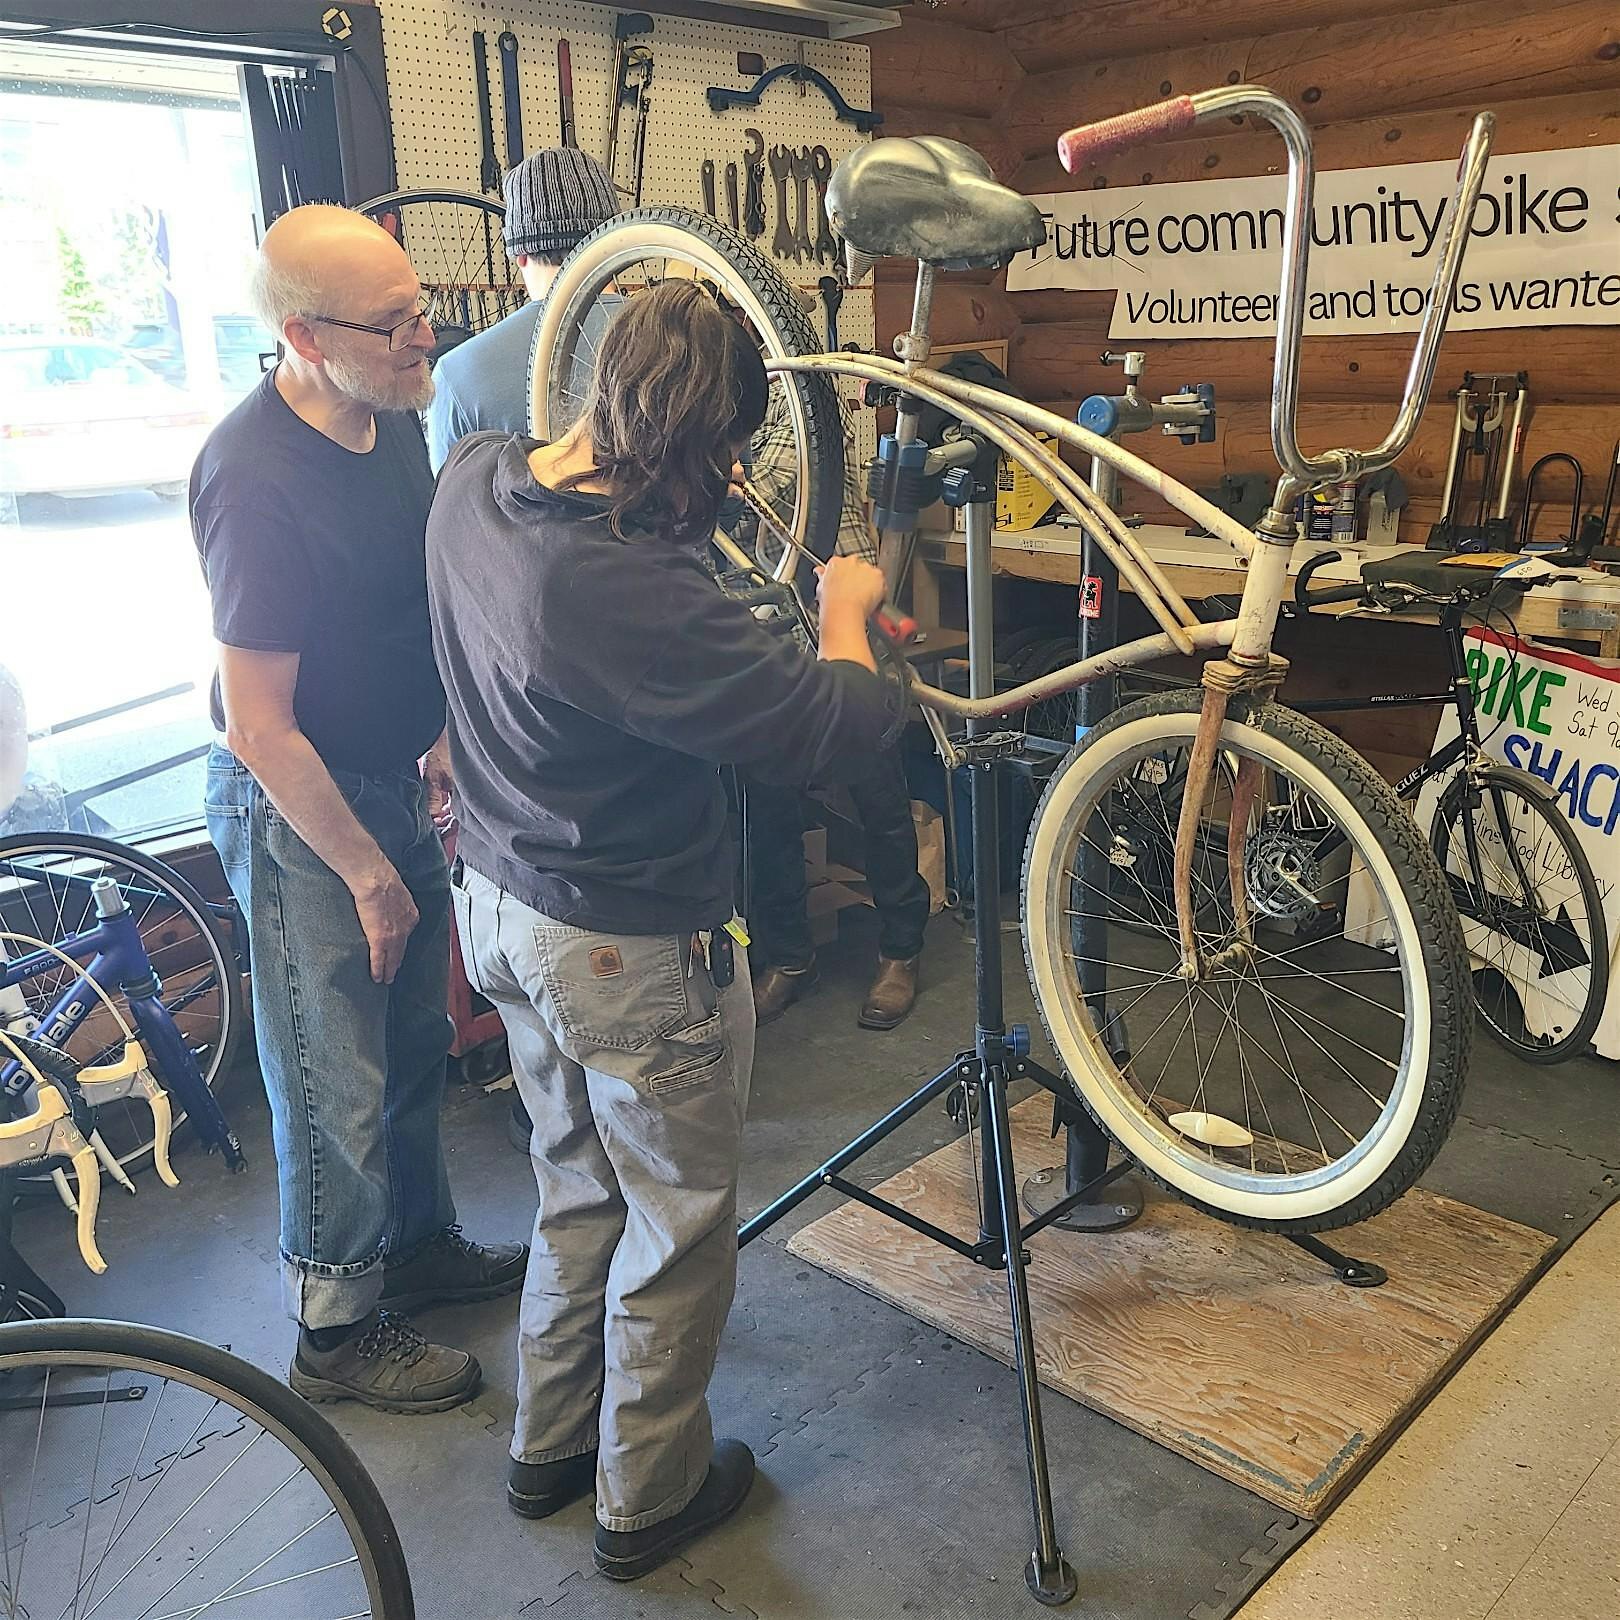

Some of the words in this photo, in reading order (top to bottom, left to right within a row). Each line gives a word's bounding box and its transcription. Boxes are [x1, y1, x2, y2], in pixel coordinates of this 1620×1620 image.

[1308, 279, 1377, 320] and
[1382, 281, 1482, 318] tols
[1466, 648, 1567, 736] BIKE
[1577, 682, 1613, 713] Wed
[1567, 710, 1599, 739] Sat
[1542, 841, 1615, 901] Liby
